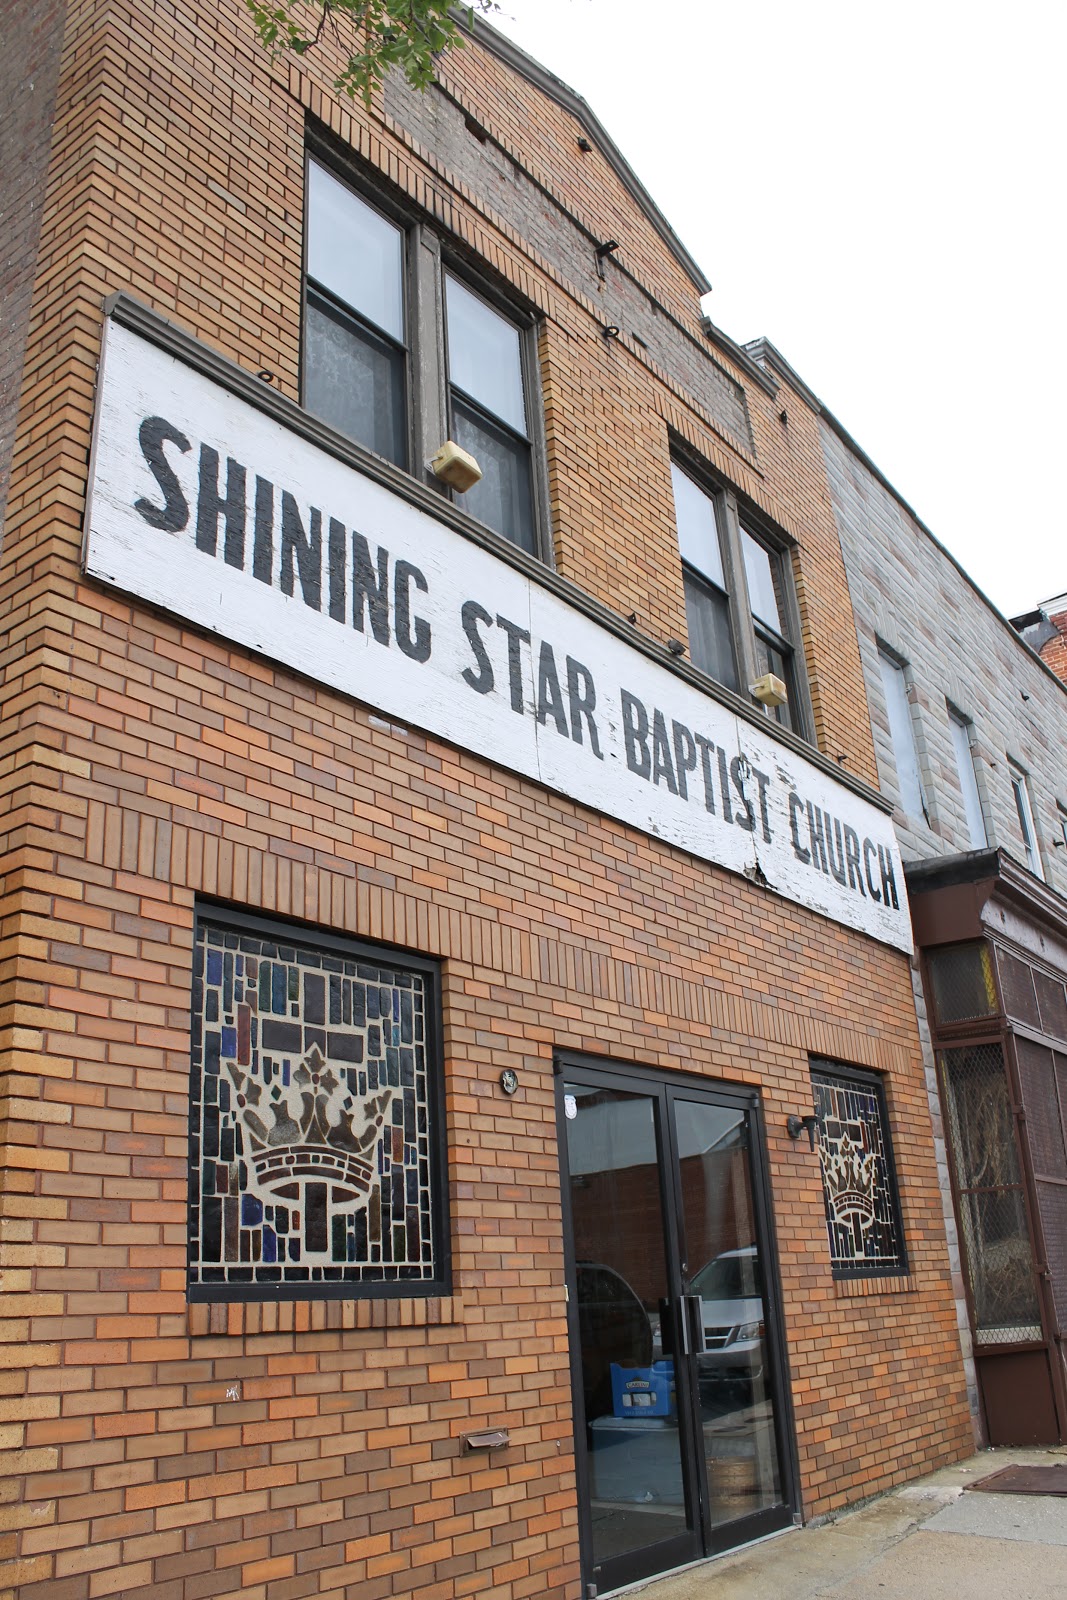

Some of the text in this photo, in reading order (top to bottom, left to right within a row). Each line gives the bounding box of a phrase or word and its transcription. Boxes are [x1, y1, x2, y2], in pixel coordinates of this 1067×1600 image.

[134, 416, 899, 910] SHINING STAR BAPTIST CHURCH
